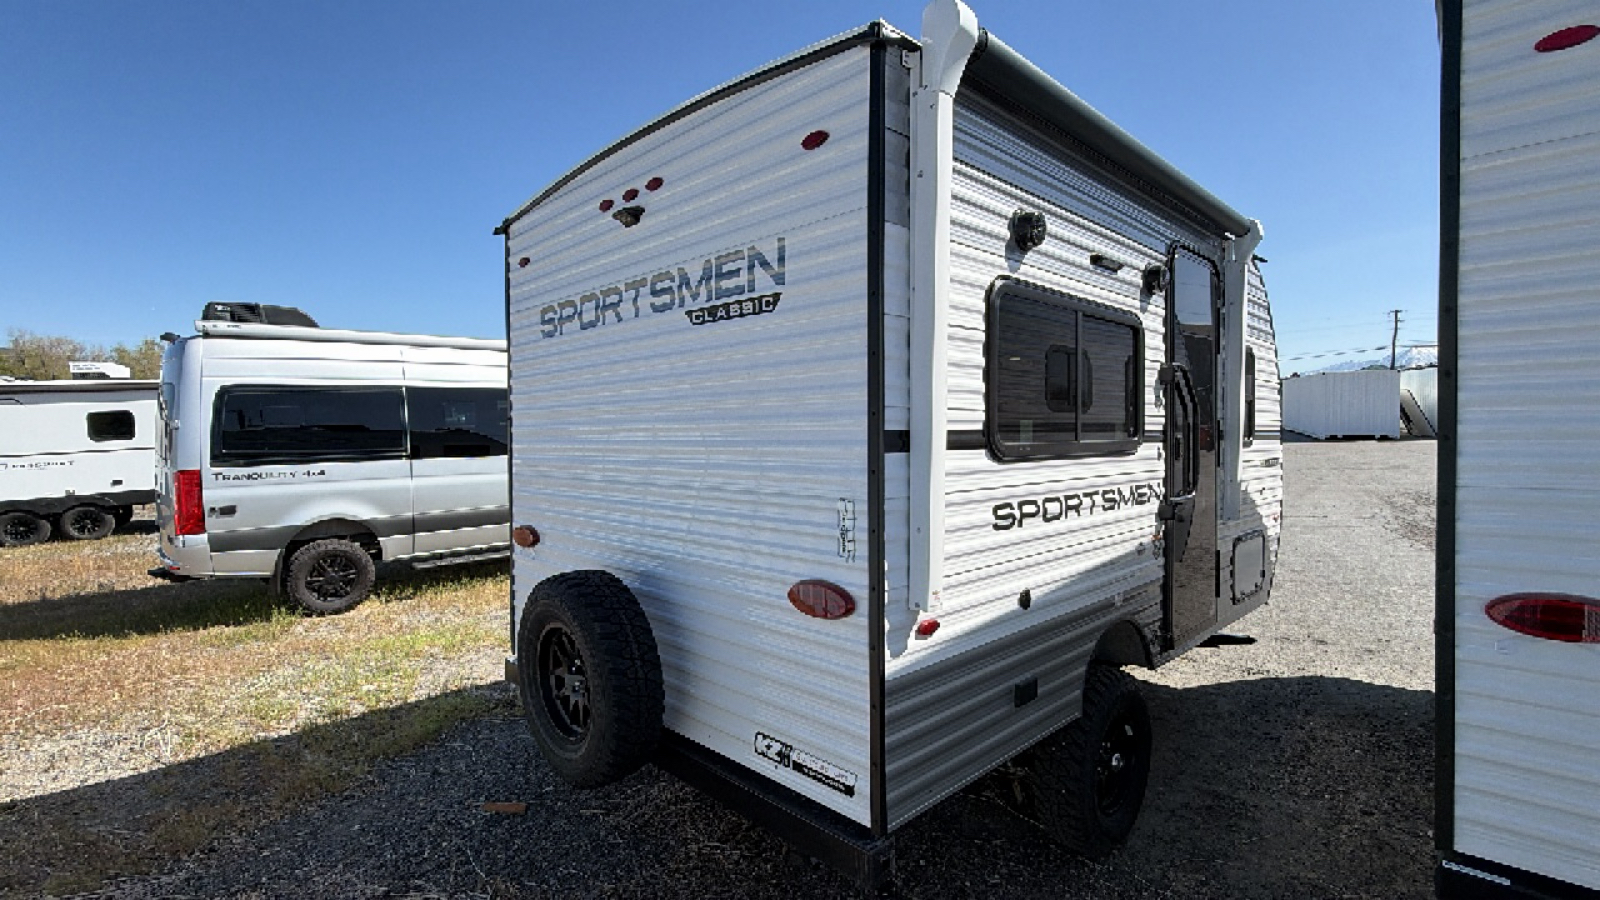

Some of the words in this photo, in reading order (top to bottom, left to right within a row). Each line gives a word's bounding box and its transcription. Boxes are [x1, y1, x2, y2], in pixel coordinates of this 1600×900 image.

[539, 237, 786, 339] SPORTSMEN
[691, 297, 774, 323] CLASSIC
[992, 482, 1163, 531] SPORTSMEN
